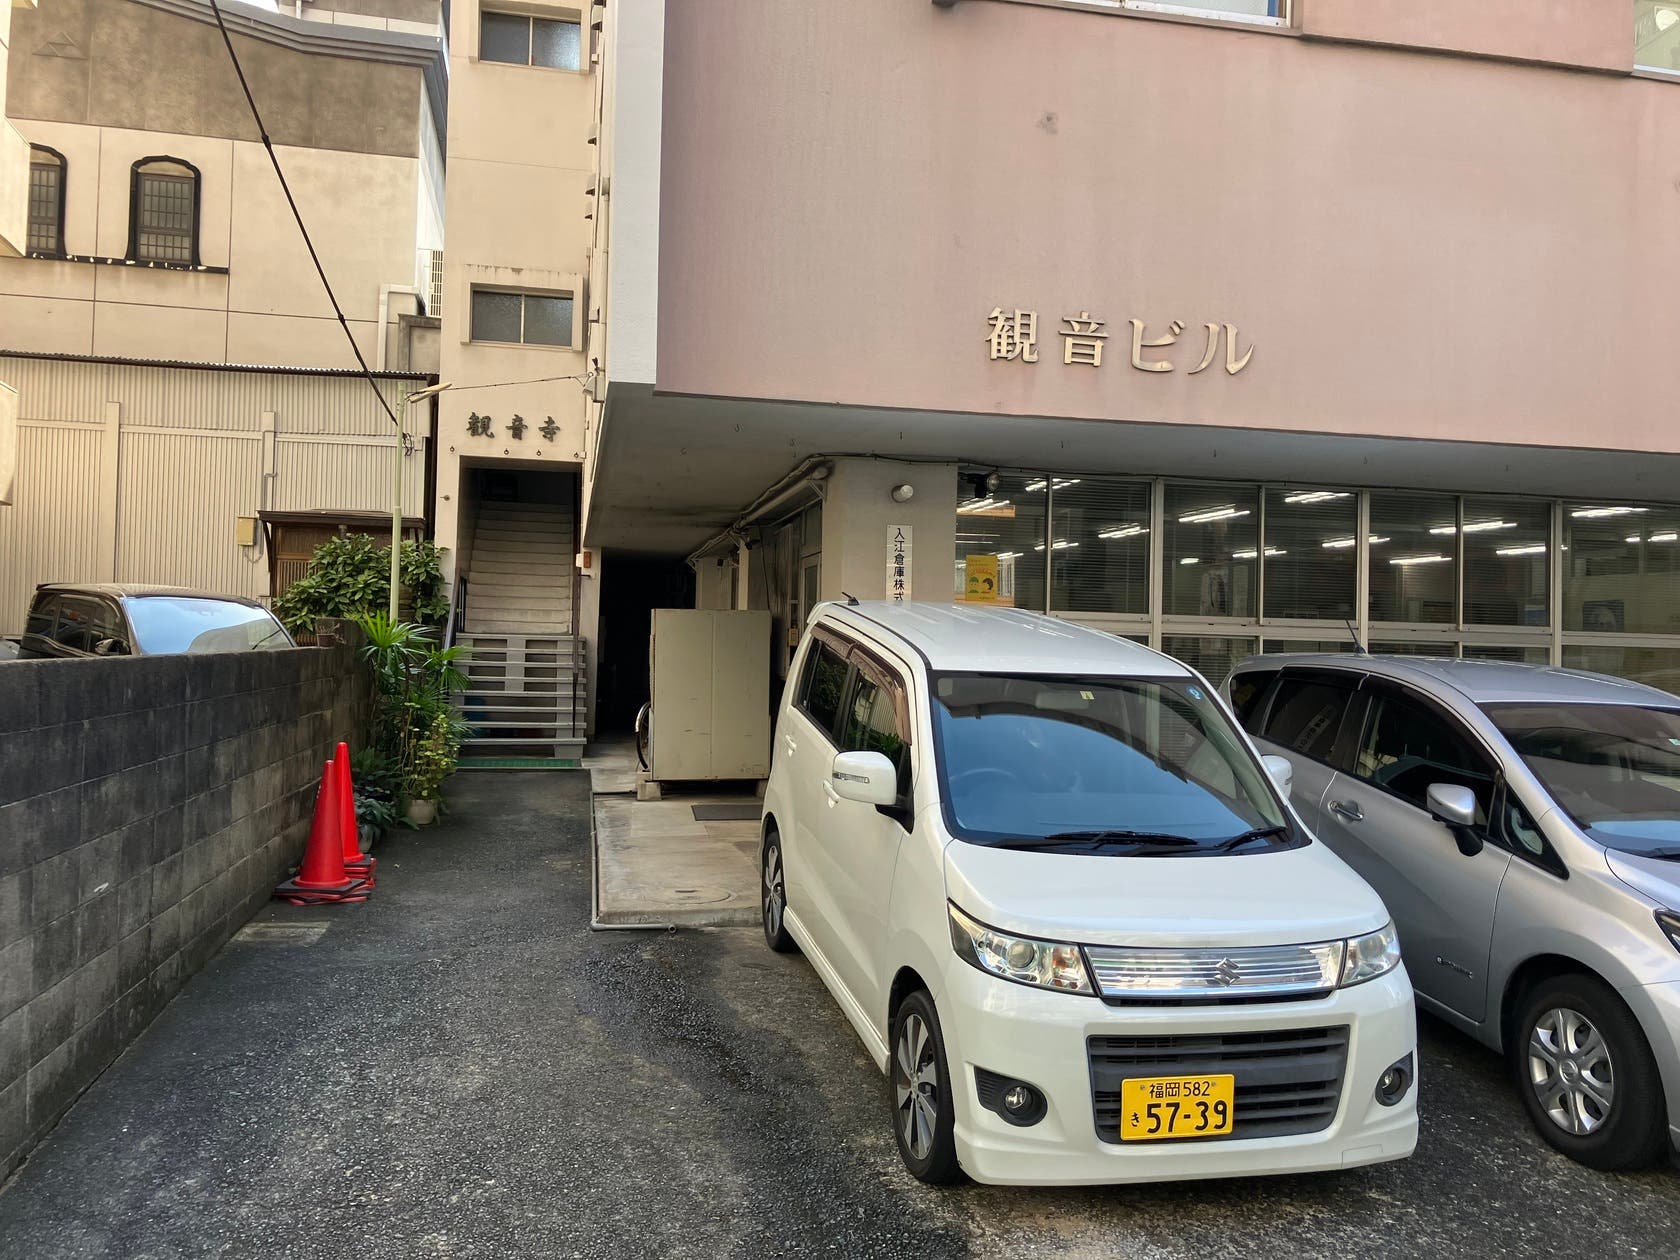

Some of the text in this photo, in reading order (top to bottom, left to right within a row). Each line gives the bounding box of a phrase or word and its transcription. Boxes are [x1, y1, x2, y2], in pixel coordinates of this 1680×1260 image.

[985, 306, 1255, 376] 観音ビル
[1149, 1081, 1211, 1099] 福岡 582
[1130, 1100, 1228, 1134] き 57-39
